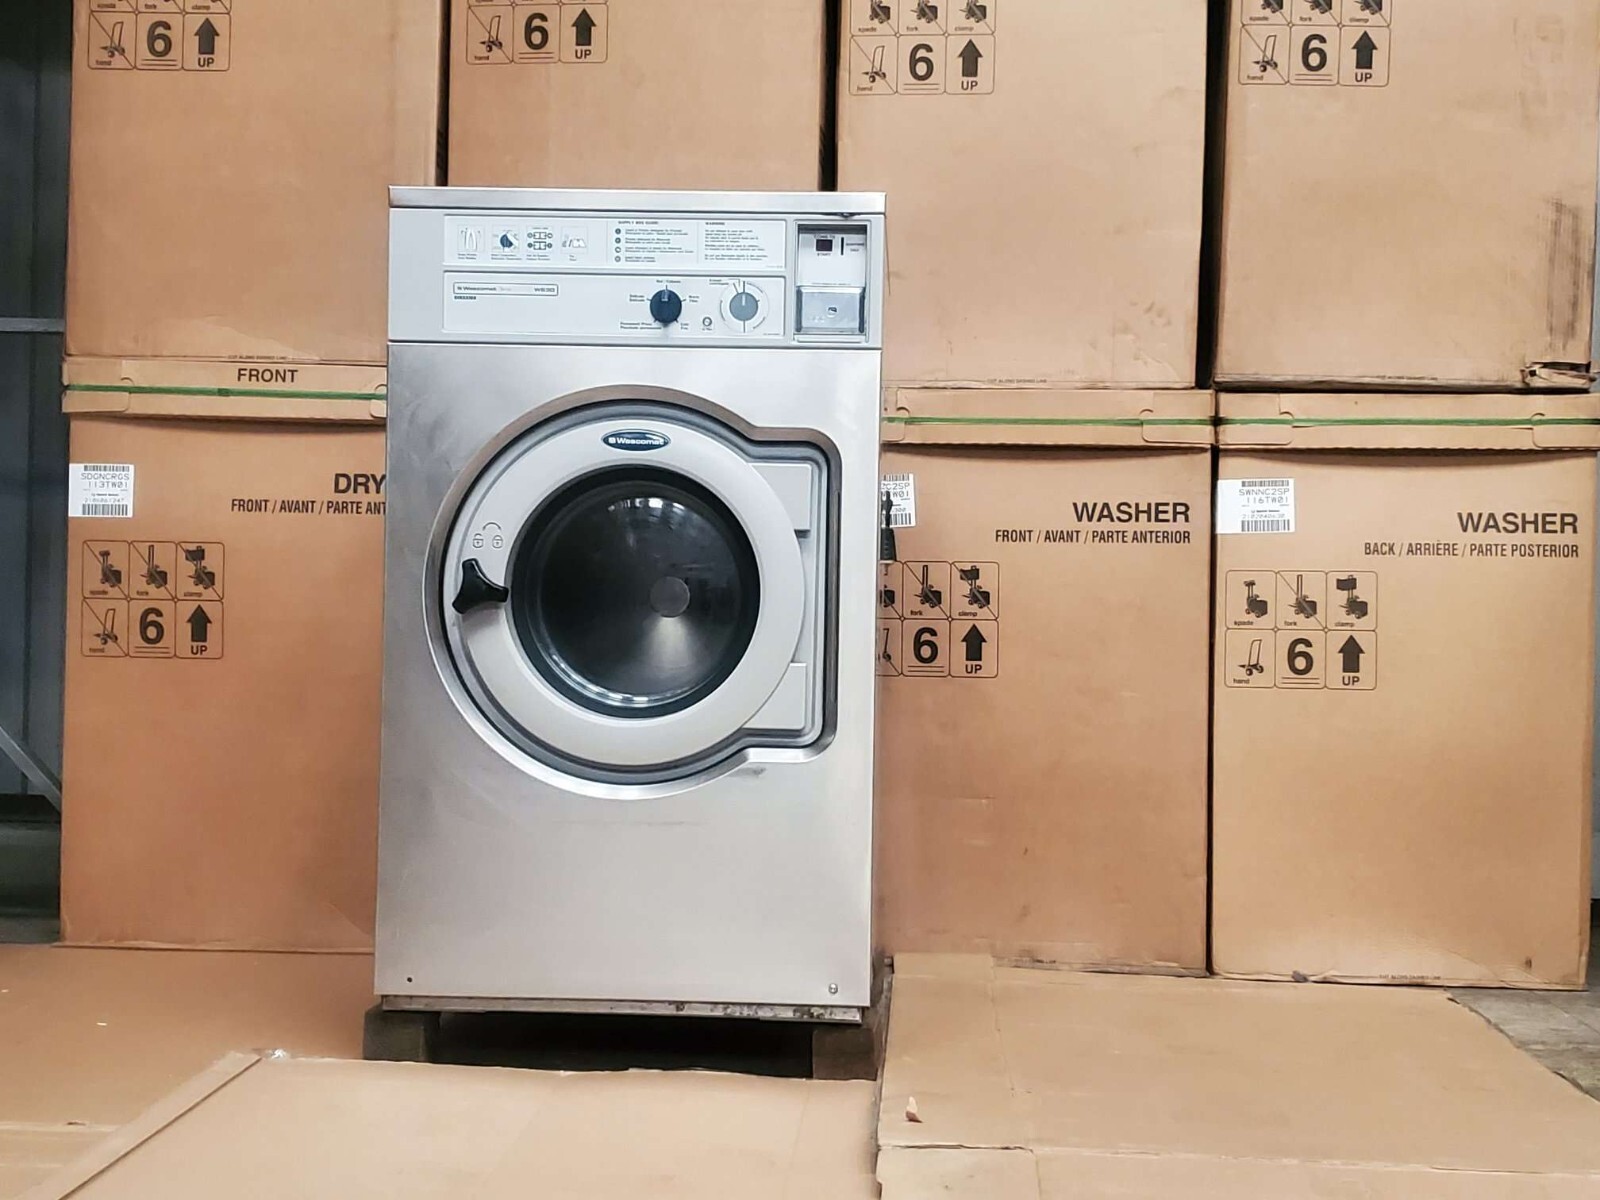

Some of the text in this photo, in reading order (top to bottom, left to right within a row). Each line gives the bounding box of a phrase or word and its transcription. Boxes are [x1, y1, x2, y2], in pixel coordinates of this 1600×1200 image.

[147, 20, 172, 57] 6
[524, 12, 549, 50] 6
[574, 49, 592, 60] UP
[1301, 33, 1328, 72] 6
[197, 57, 215, 68] UP
[909, 43, 934, 81] 6
[1354, 72, 1373, 83] UP
[960, 80, 978, 91] UP
[237, 368, 298, 383] FRONT
[616, 437, 664, 446] Wascomat
[334, 473, 386, 494] DRY
[1239, 488, 1290, 496] SWNNC2SP
[231, 499, 269, 513] FRONT
[279, 500, 316, 513] AVANT
[326, 501, 362, 514] PARTE
[1072, 502, 1190, 523] WASHER
[1457, 512, 1578, 534] WASHER
[995, 529, 1033, 543] FRONT
[1044, 530, 1081, 543] AVANT
[1092, 530, 1128, 543] PARTE
[1131, 530, 1191, 544] ANTERIOR
[1364, 542, 1396, 556] BACK
[1406, 540, 1459, 557] ARRIÈRE
[1469, 543, 1507, 557] PARTE
[1511, 544, 1579, 558] POSTERIOR
[139, 607, 165, 645] 6
[190, 645, 208, 655] UP
[913, 626, 939, 664] 6
[1287, 637, 1314, 676] 6
[965, 664, 982, 674] UP
[1341, 676, 1360, 686] UP
